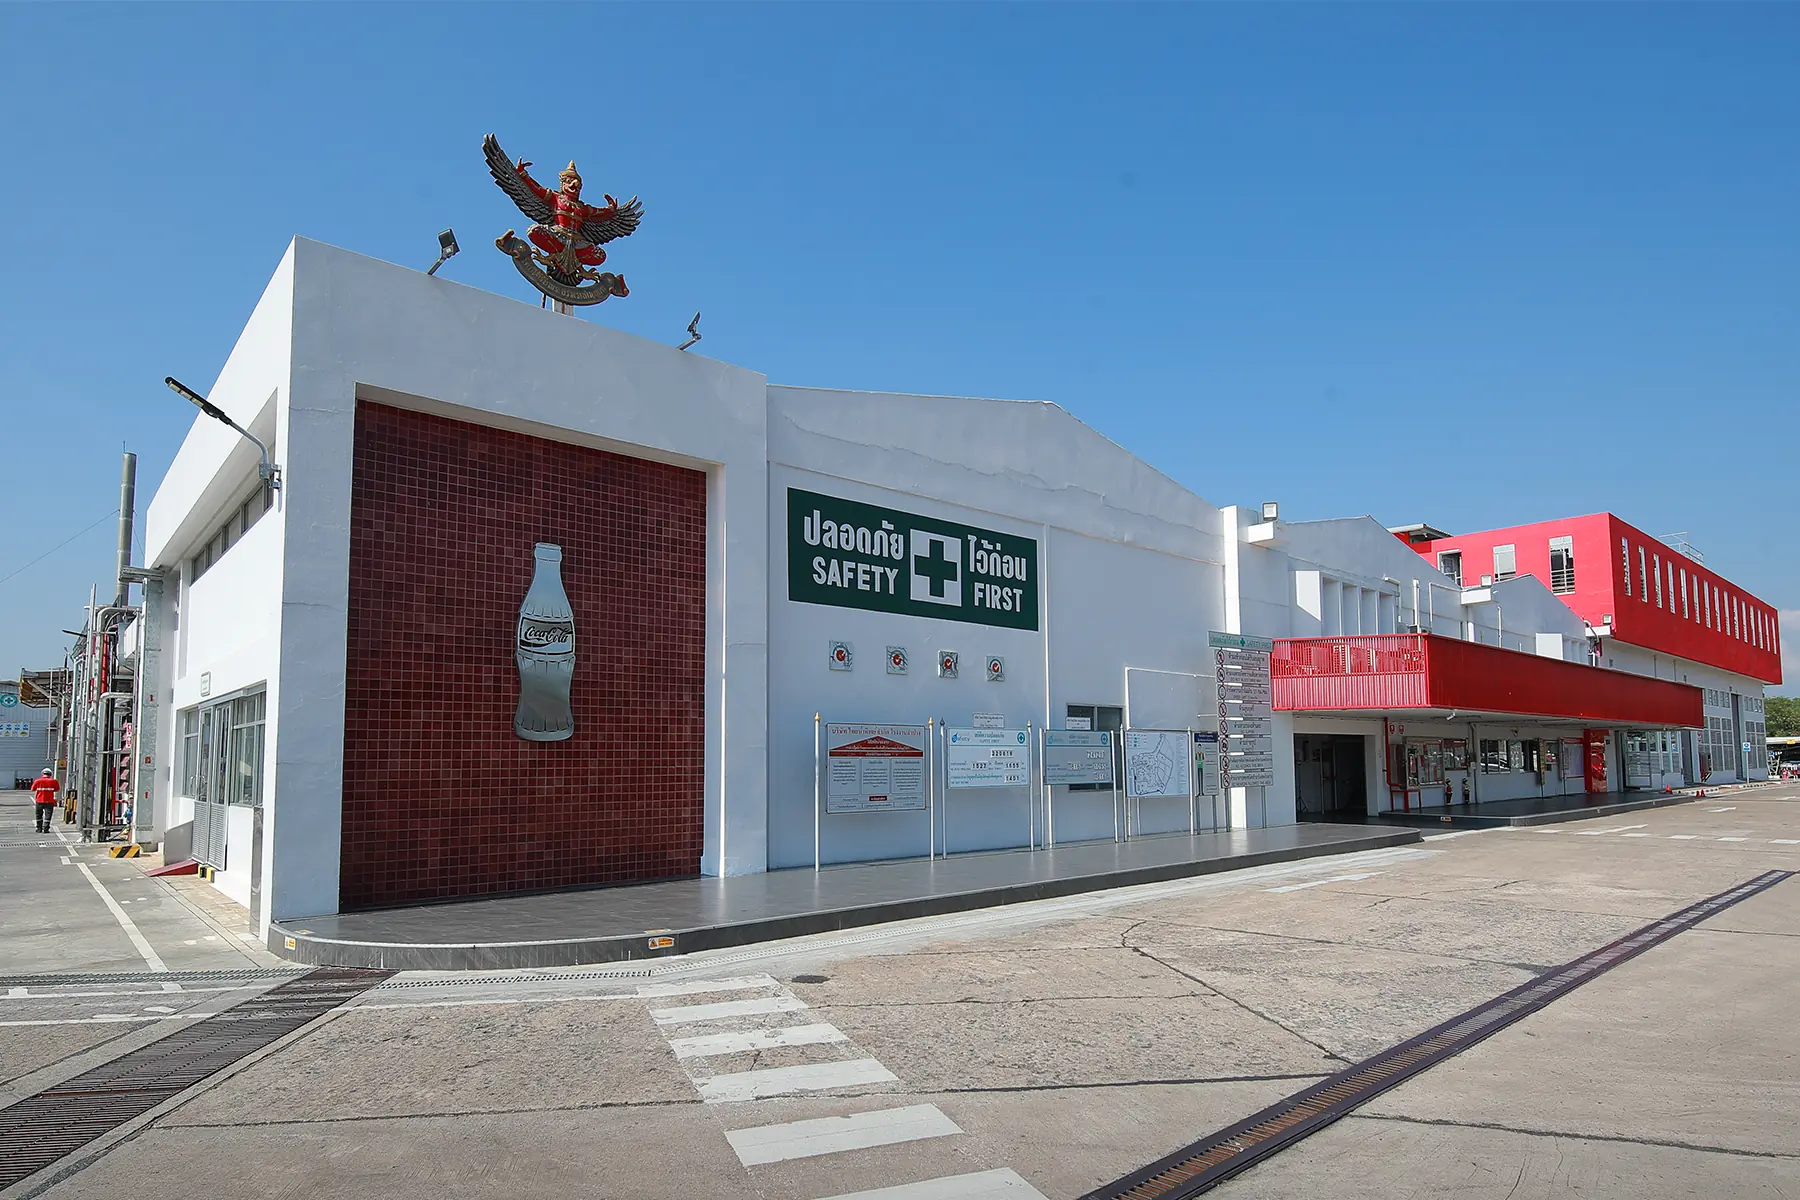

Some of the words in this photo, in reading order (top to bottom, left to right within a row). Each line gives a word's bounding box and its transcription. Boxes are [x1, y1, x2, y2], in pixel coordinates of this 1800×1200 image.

[803, 509, 904, 561] ปลอดภัย
[967, 534, 1028, 582] ไว้ก่อน
[812, 556, 899, 595] SAFETY
[974, 582, 1023, 613] FIRST
